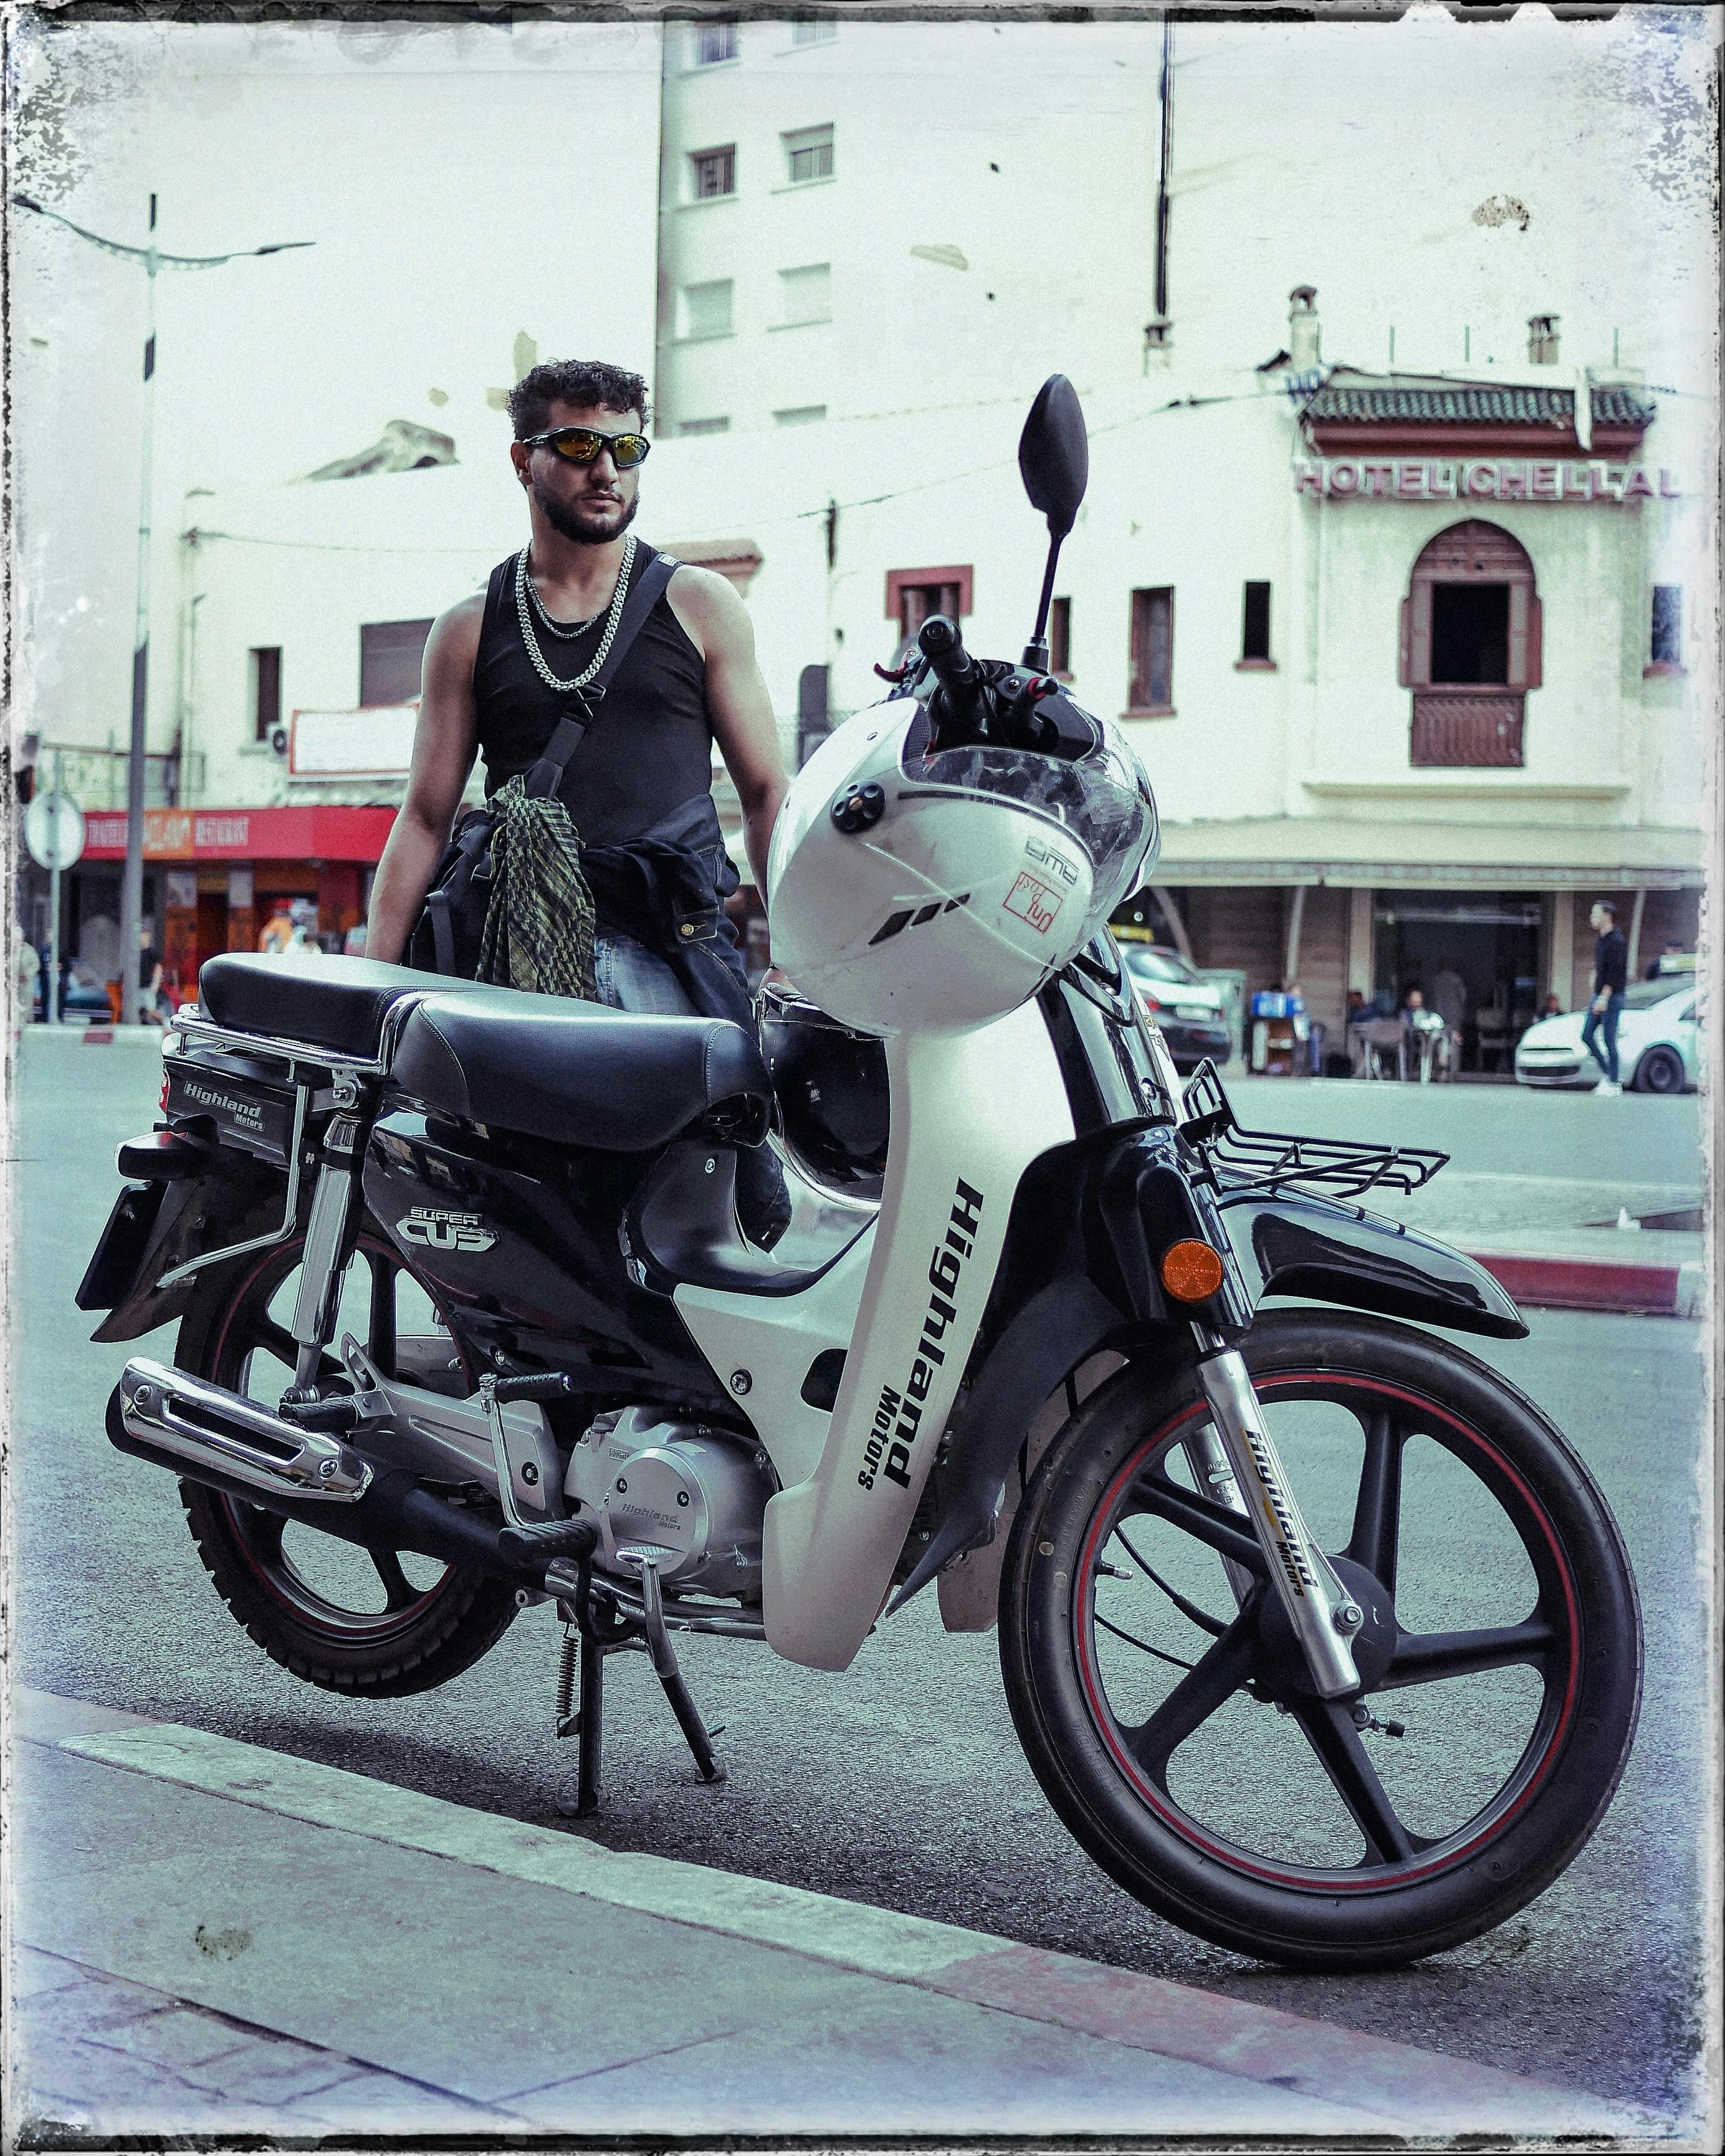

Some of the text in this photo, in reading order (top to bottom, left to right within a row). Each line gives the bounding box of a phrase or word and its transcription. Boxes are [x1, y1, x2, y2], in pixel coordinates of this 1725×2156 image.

[1296, 457, 1683, 499] HOTEL CHELLAL
[1024, 902, 1054, 935] Uni
[185, 1083, 262, 1119] Highland
[235, 1113, 264, 1130] Motors
[410, 1208, 479, 1225] SUPER
[396, 1218, 496, 1252] CUB
[882, 1176, 984, 1490] Highland
[857, 1383, 902, 1491] Motors
[622, 1503, 679, 1524] Highland
[1275, 1540, 1306, 1597] Motors
